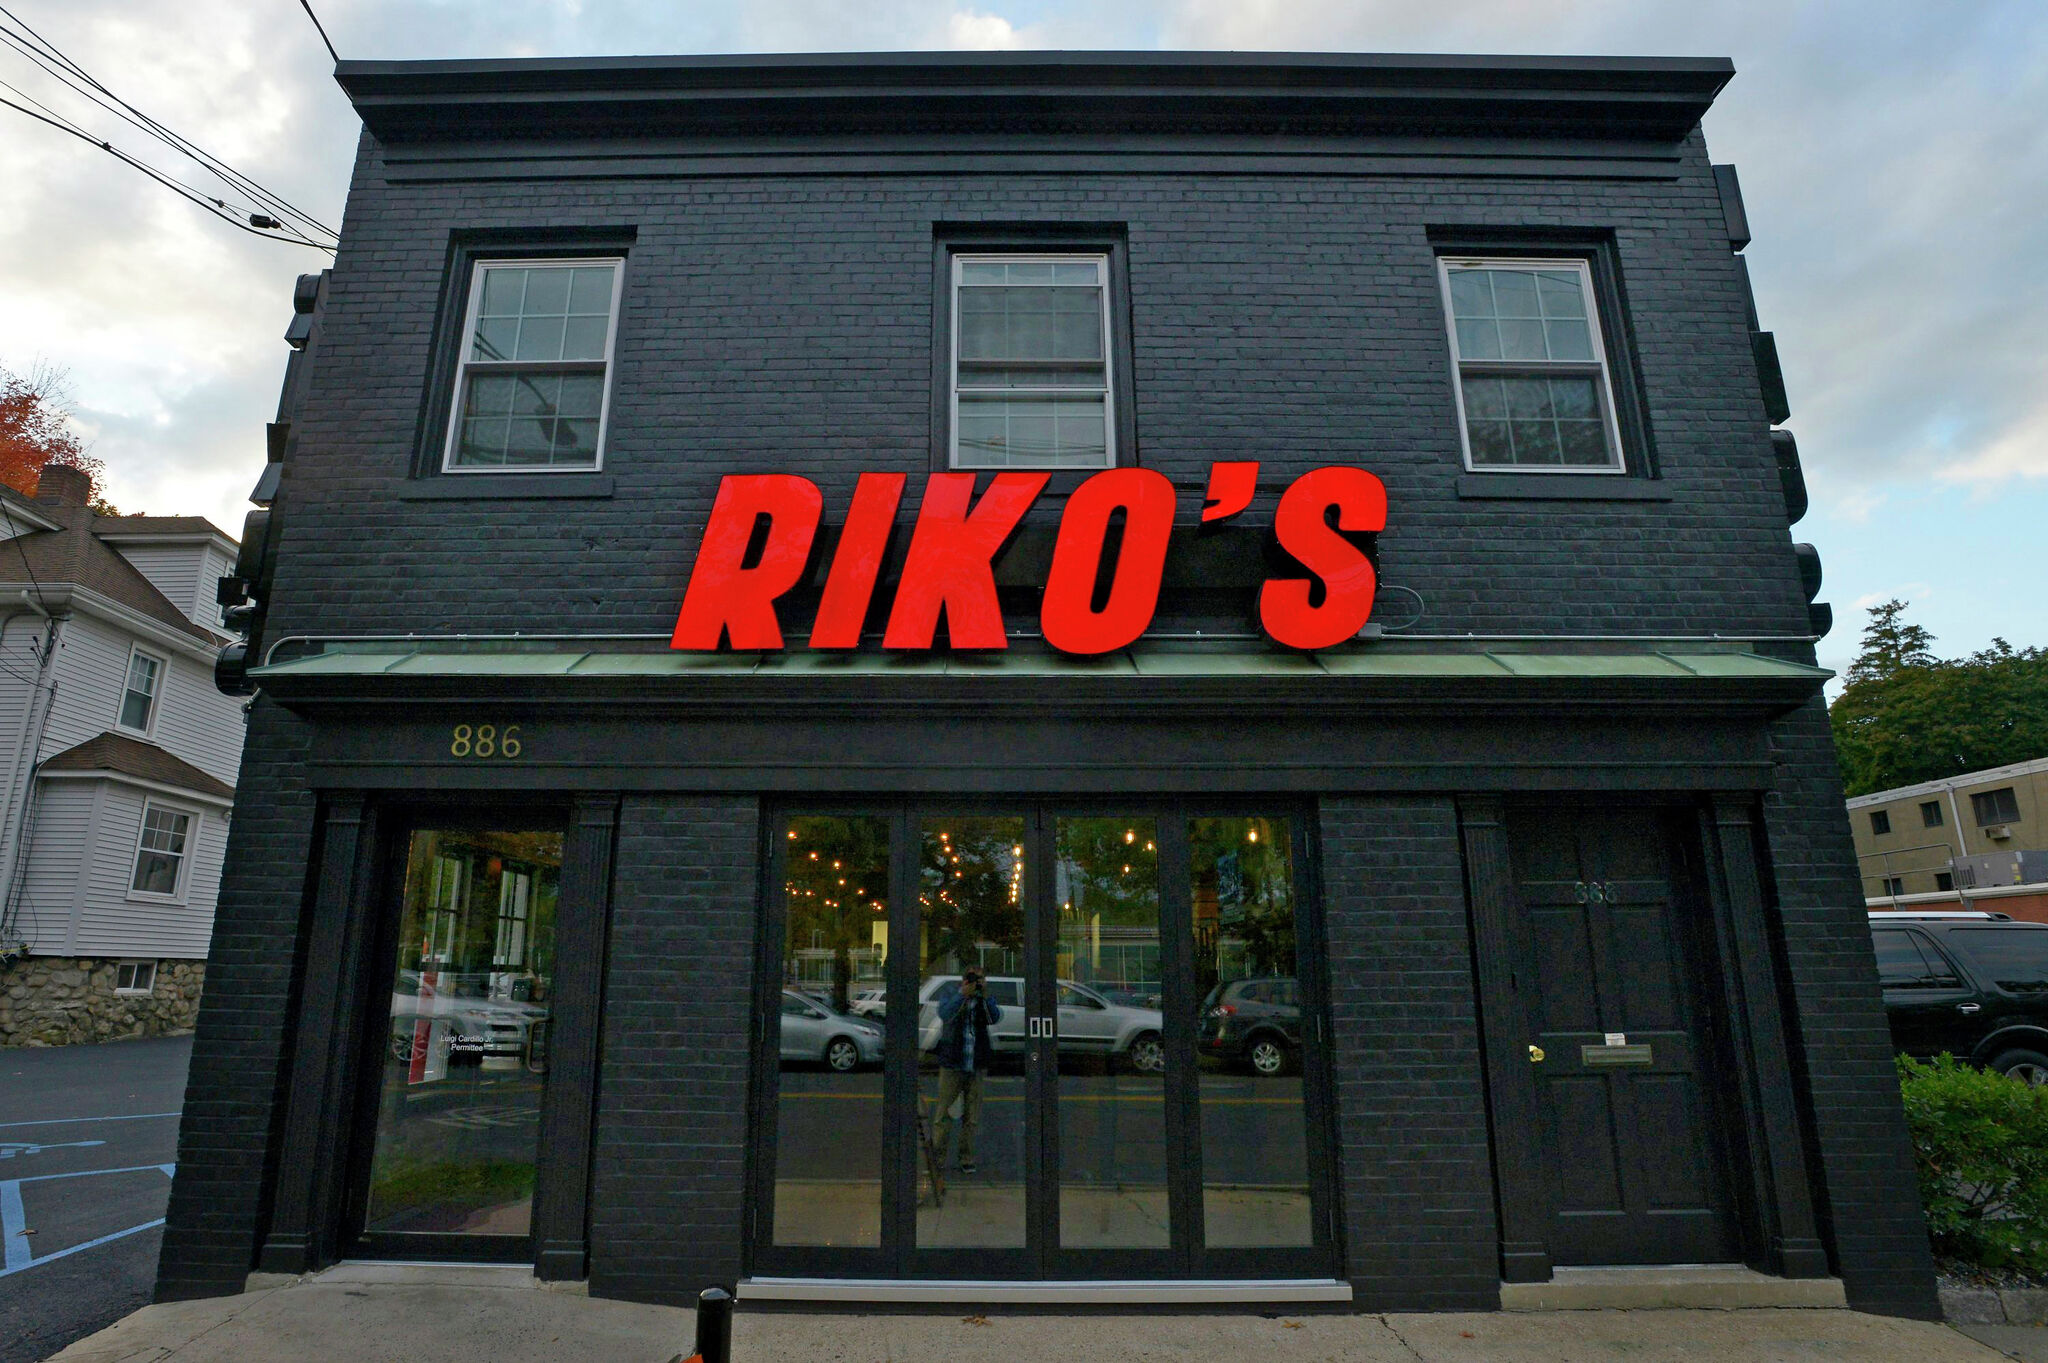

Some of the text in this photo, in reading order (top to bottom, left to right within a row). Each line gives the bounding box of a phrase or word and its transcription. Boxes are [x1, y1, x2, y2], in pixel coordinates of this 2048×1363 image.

[670, 461, 1388, 655] RIKO'S
[451, 724, 521, 757] 886
[440, 1034, 457, 1043] Luigi
